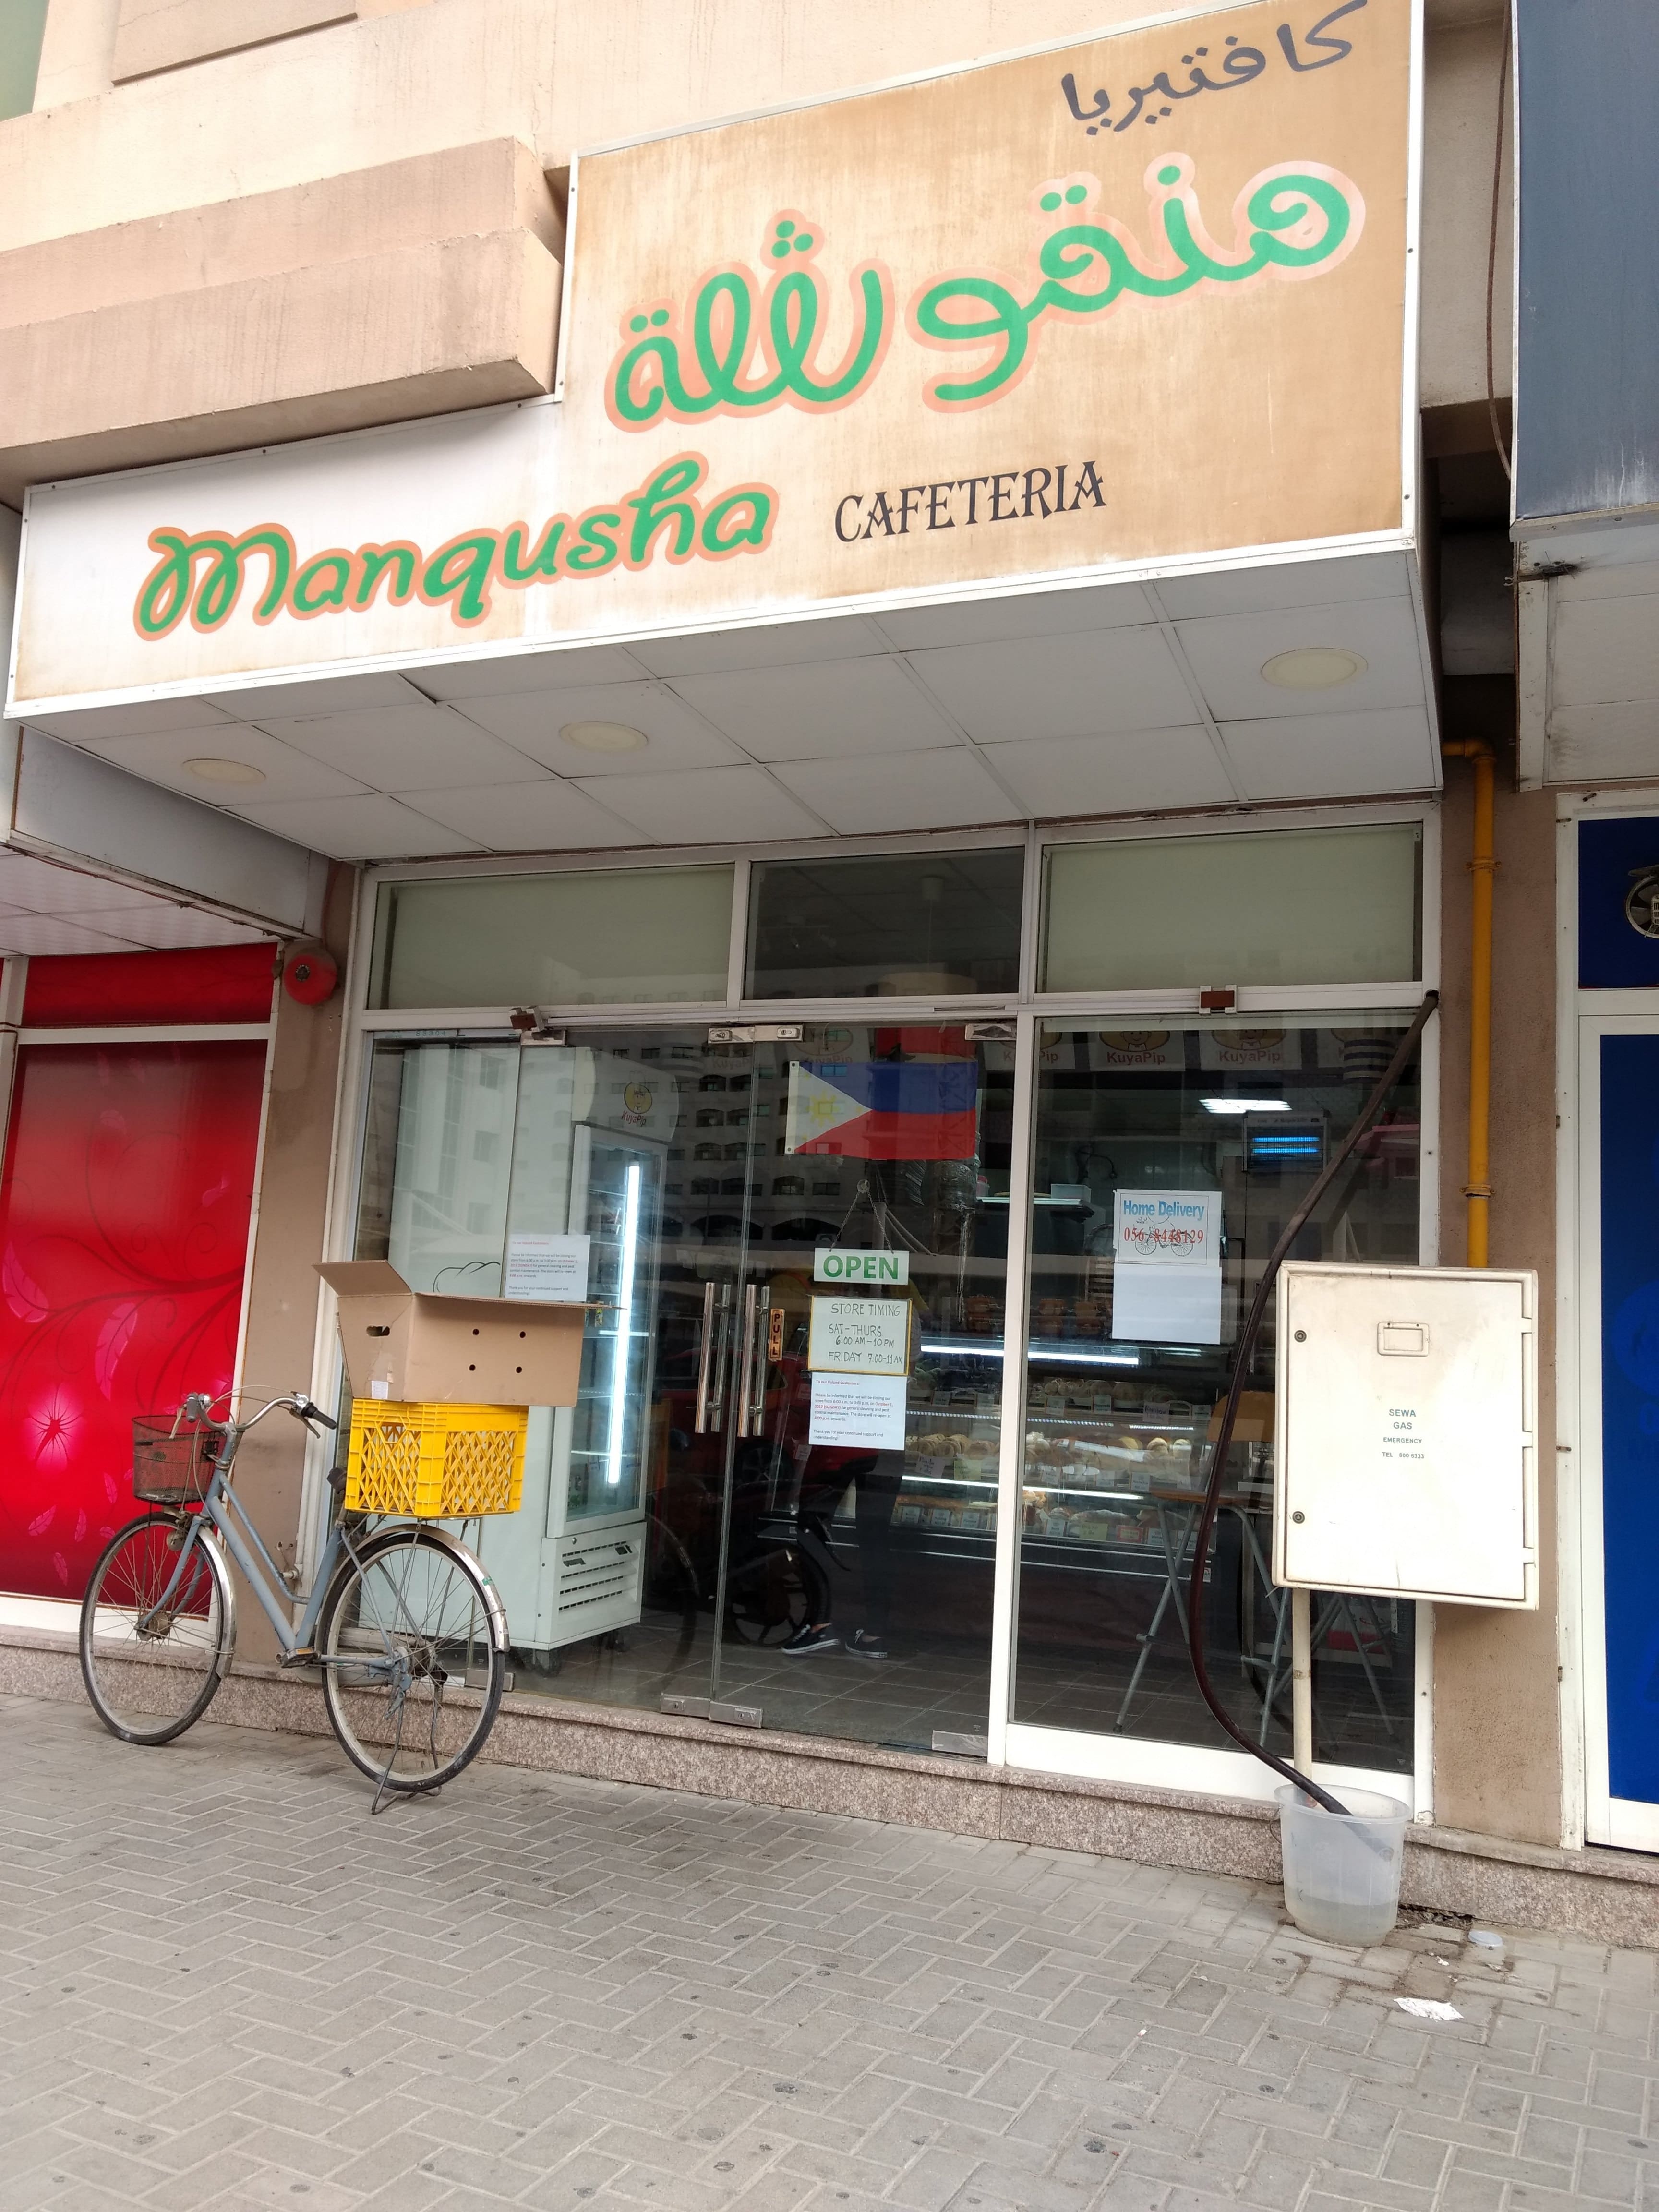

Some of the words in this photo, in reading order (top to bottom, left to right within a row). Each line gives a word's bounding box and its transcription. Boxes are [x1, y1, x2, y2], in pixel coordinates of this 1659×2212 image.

[834, 459, 1108, 543] CAFETERIA
[137, 458, 772, 634] Manqusha
[1106, 1052, 1166, 1065] KuyaPip
[1219, 1050, 1282, 1064] KuyaPip
[621, 1110, 647, 1127] KuyaPip
[1123, 1200, 1155, 1216] Home
[1158, 1200, 1205, 1221] Delivery
[823, 1255, 899, 1279] OPEN
[830, 1303, 865, 1315] STORE
[868, 1304, 901, 1317] TIMING
[772, 1313, 781, 1356] PULL
[835, 1335, 853, 1345] 6:00
[884, 1339, 894, 1348] PM
[828, 1351, 862, 1362] FRIDAY
[1389, 1408, 1417, 1418] SEWA
[1393, 1421, 1412, 1430] GAS
